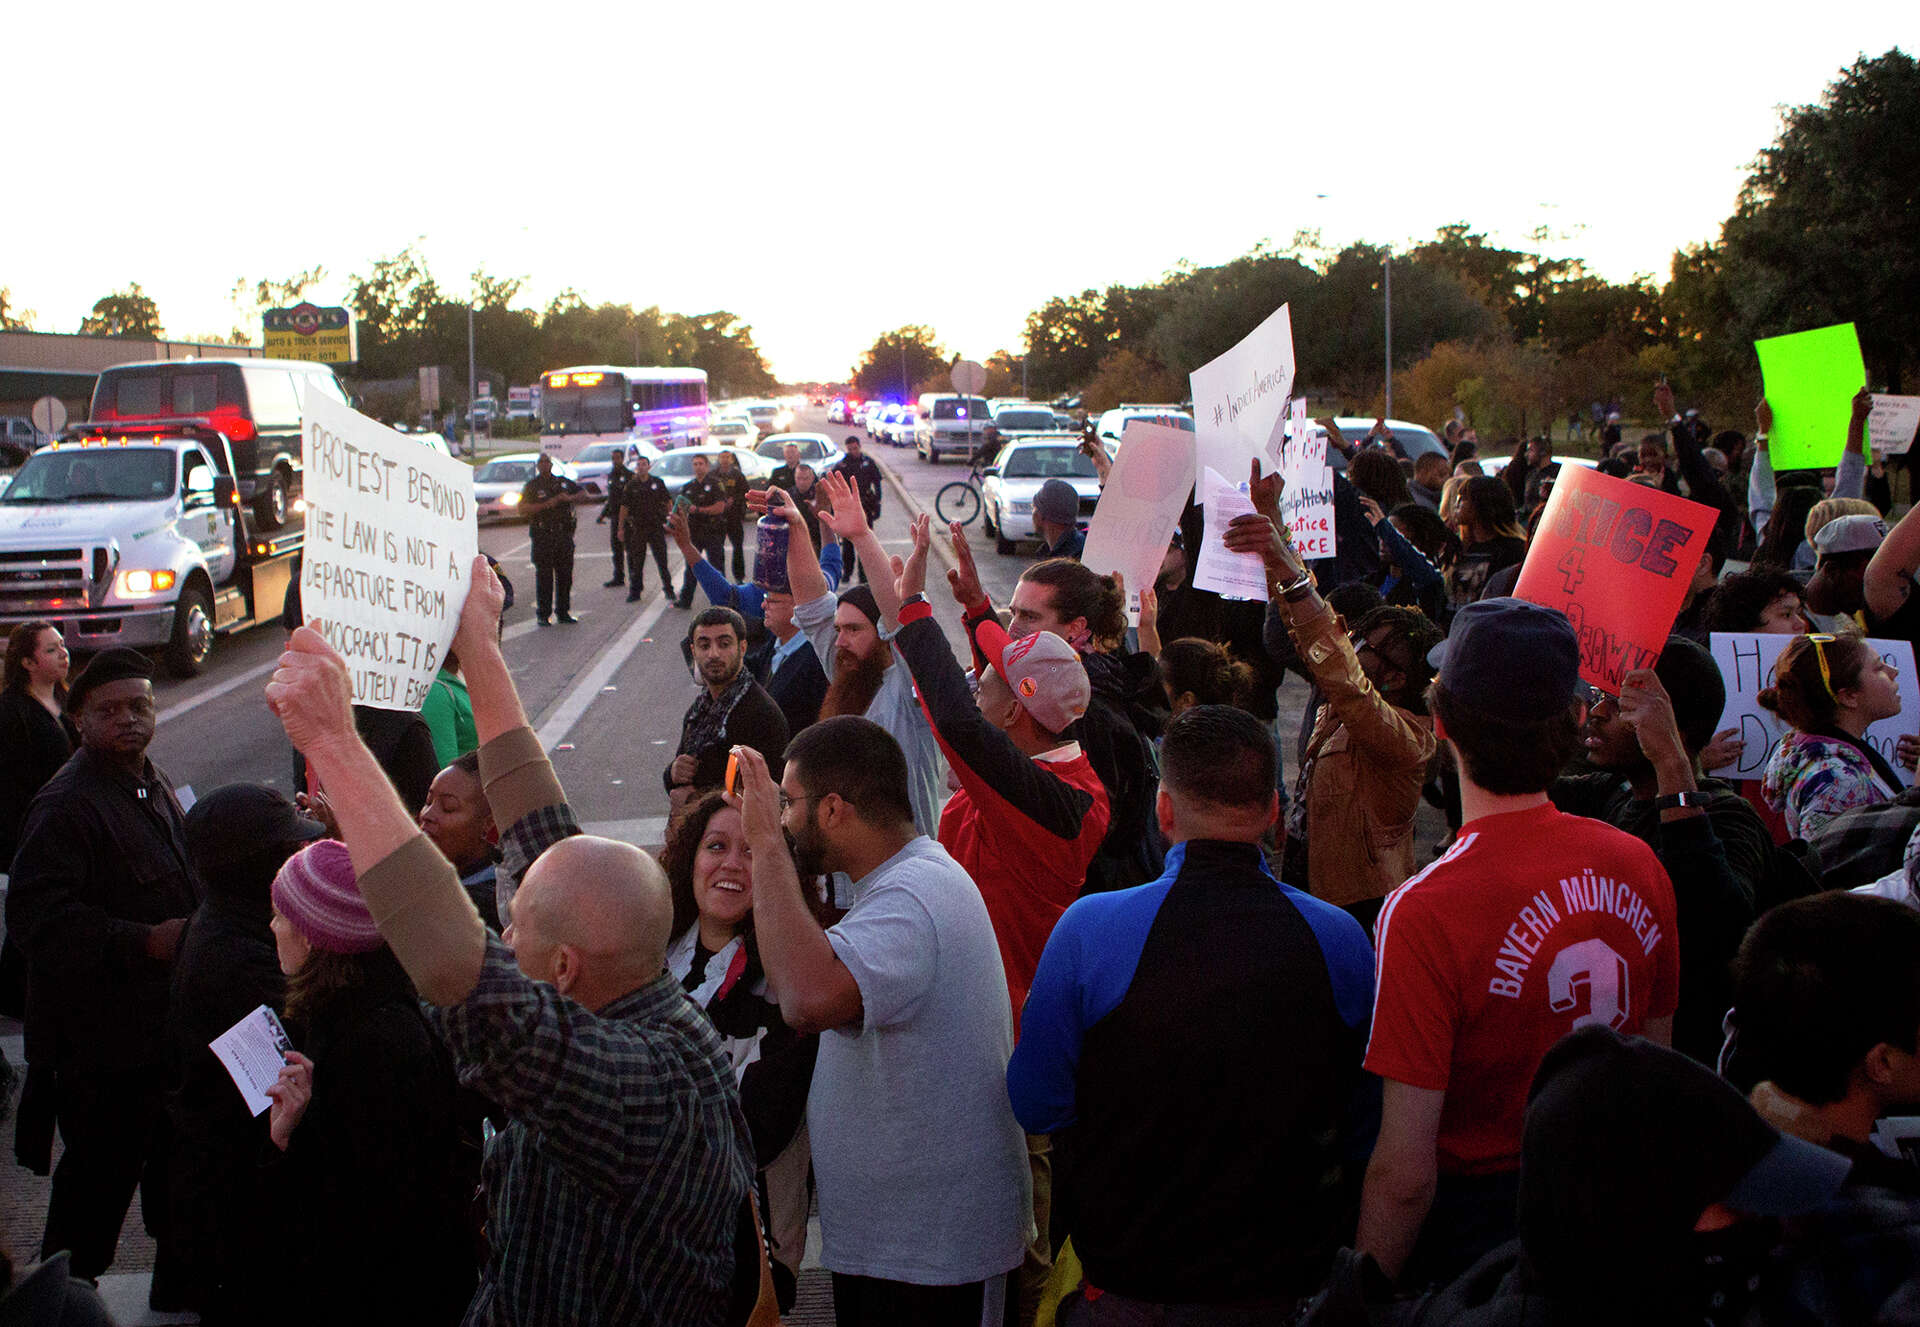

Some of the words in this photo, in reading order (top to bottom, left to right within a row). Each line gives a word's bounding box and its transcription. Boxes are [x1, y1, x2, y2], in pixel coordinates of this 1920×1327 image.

[311, 422, 398, 501] PROTEST
[407, 466, 466, 521] BEYOND
[305, 501, 334, 542] THE
[343, 511, 377, 556] LAW
[383, 530, 398, 563] IS
[406, 536, 438, 569] NOT
[448, 551, 460, 580] A
[1294, 537, 1329, 553] ACE
[1557, 546, 1585, 595] 4
[306, 559, 398, 612] DEPARTURE
[403, 580, 445, 620] FROM
[302, 614, 393, 664] MOCRACY,
[396, 631, 422, 670] IT
[424, 642, 437, 672] IS
[1488, 889, 1561, 999] BAYERN
[1559, 868, 1662, 957] MÜNCHEN
